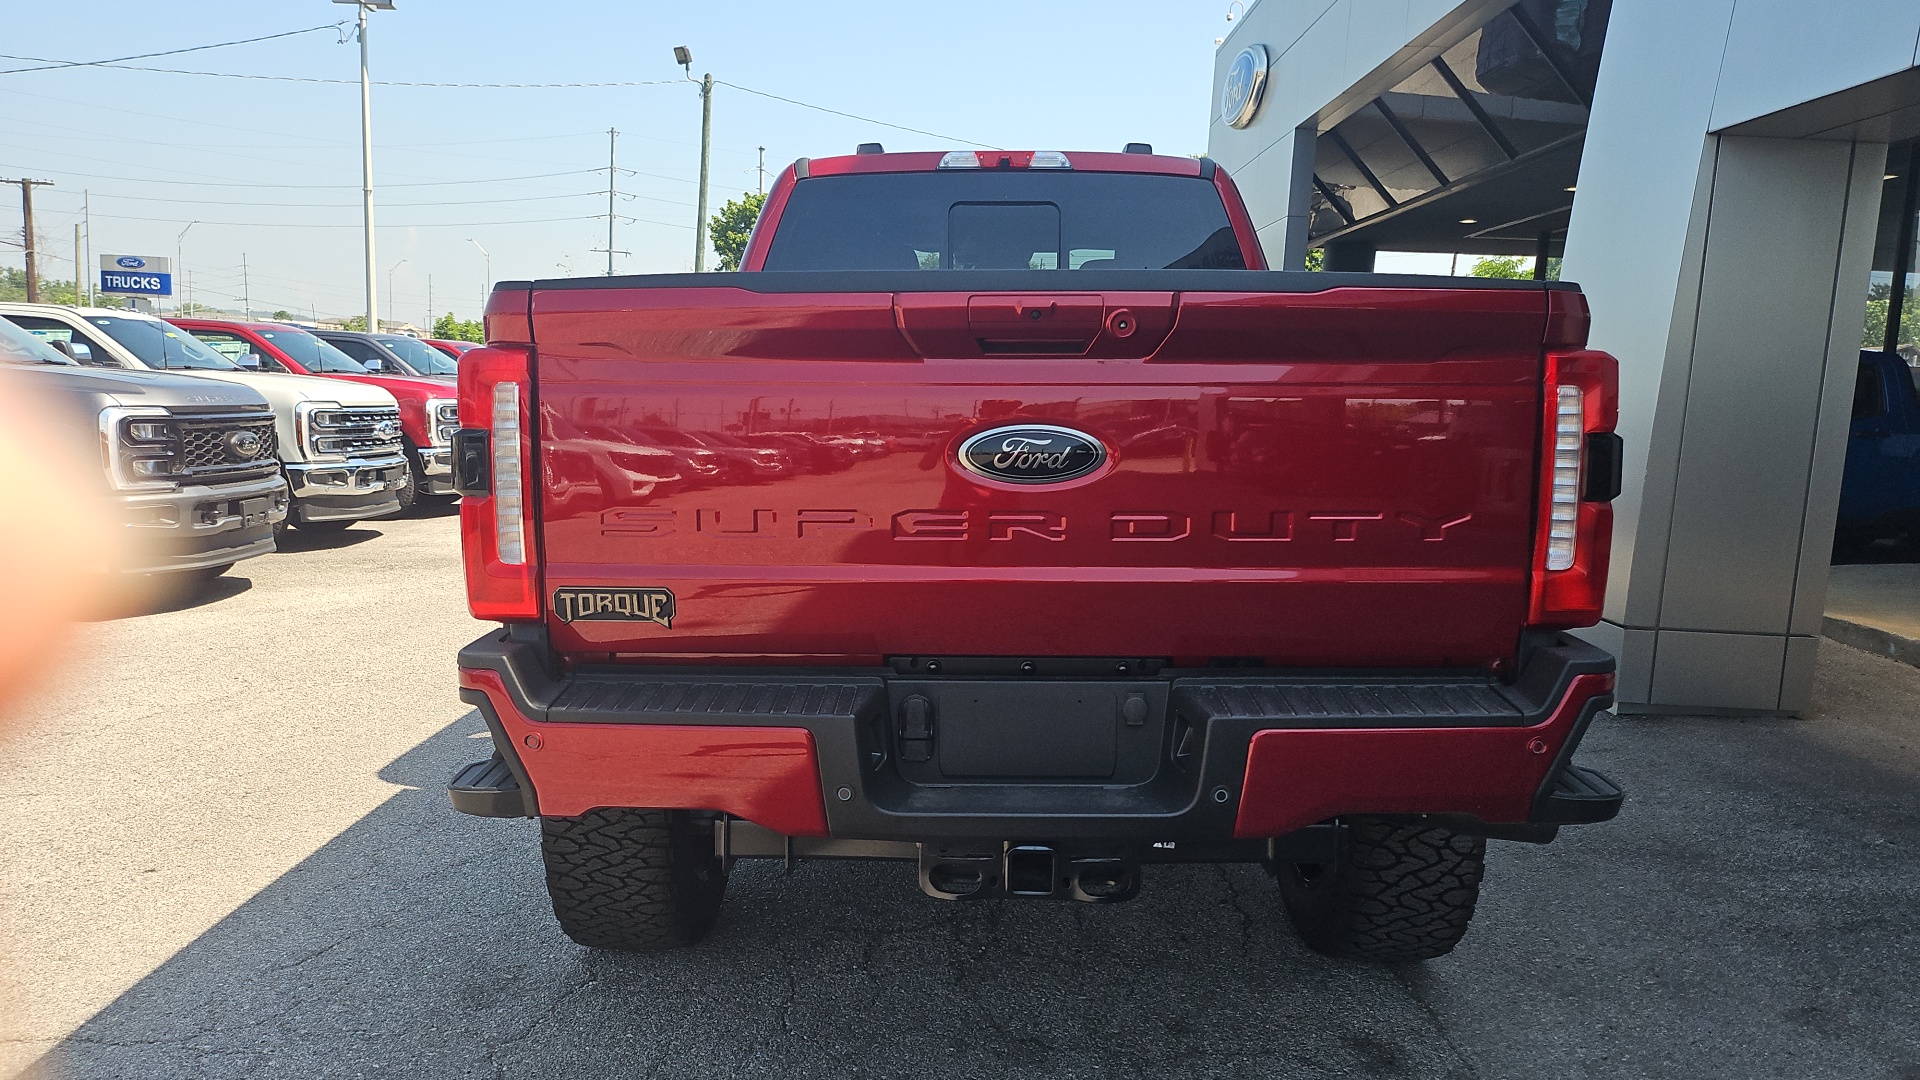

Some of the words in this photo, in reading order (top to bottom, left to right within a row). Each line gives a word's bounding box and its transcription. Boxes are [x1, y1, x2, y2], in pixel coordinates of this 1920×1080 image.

[1224, 66, 1244, 115] Ford
[120, 258, 139, 267] Ford
[105, 275, 161, 290] TRUCKS
[993, 437, 1071, 470] Ford
[600, 507, 1067, 541] SUPER
[1110, 511, 1472, 542] DUTY
[558, 591, 671, 629] TORQUE
